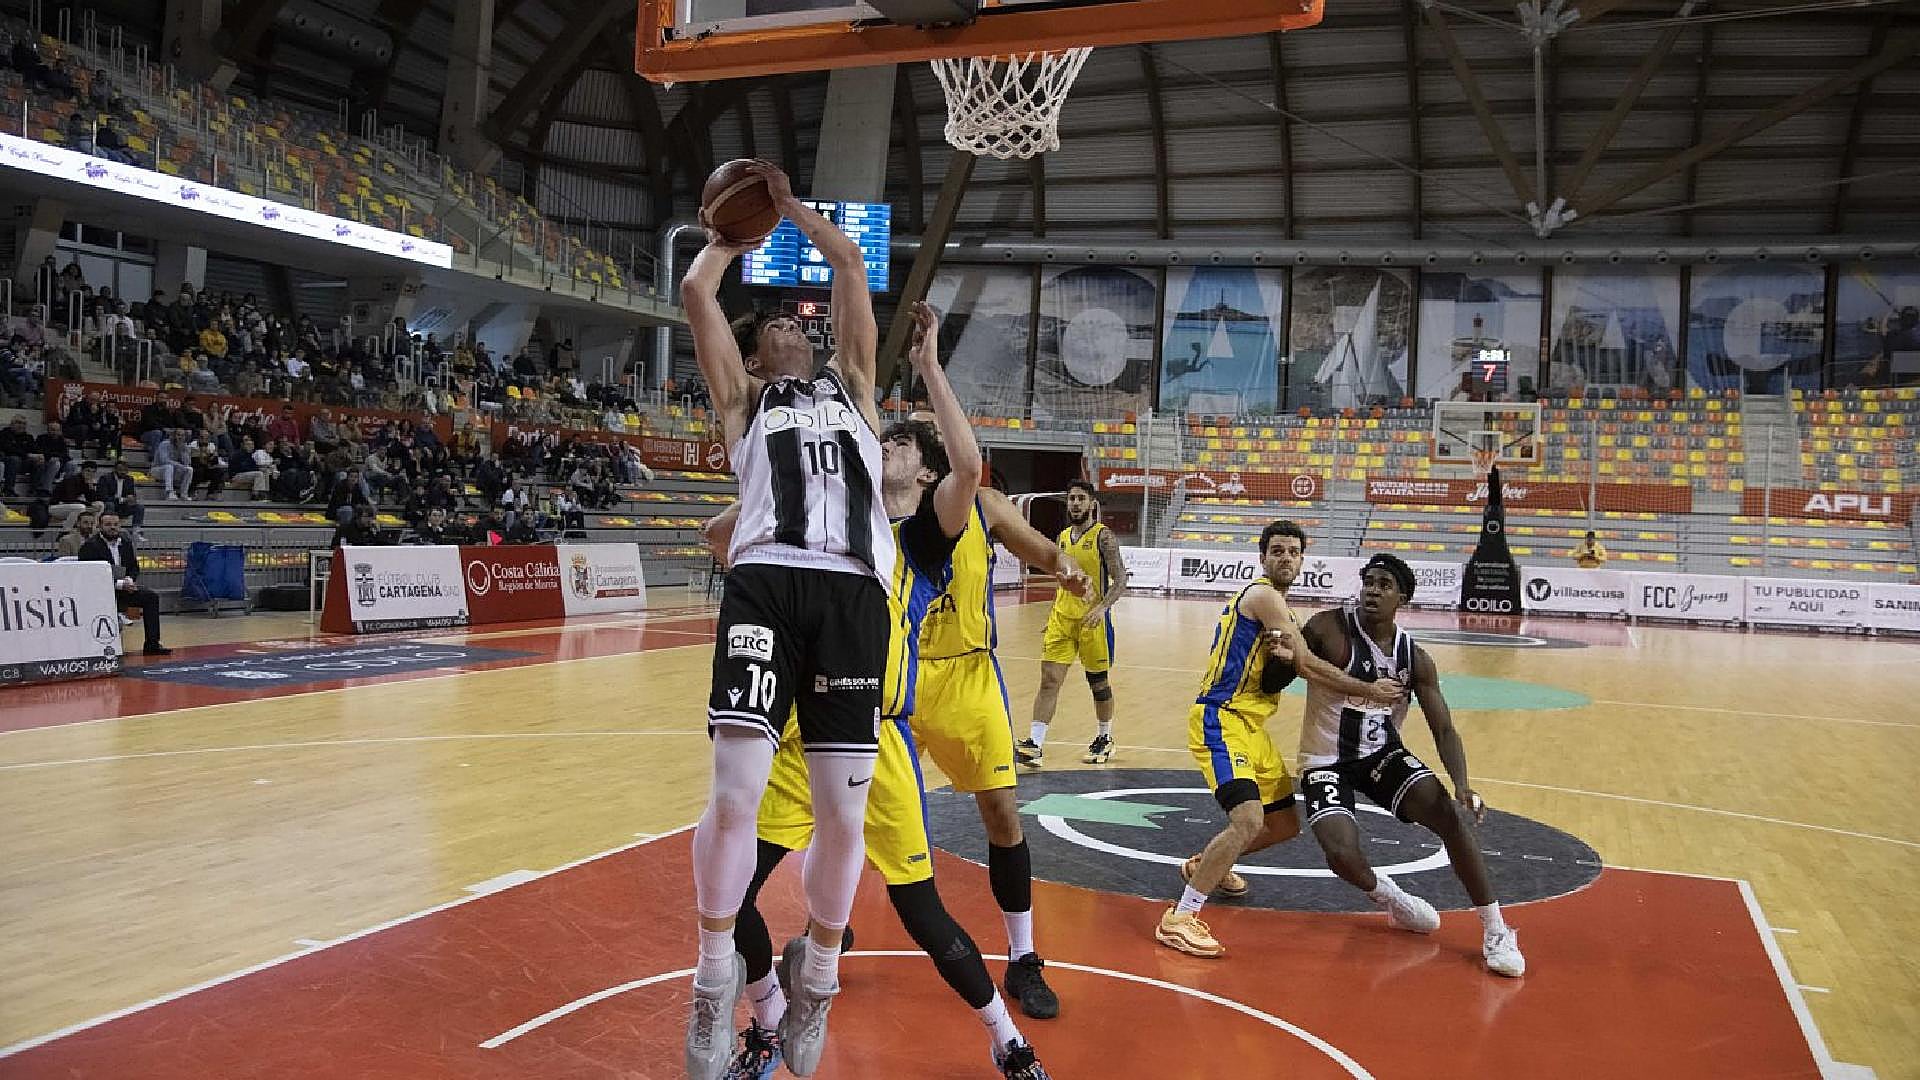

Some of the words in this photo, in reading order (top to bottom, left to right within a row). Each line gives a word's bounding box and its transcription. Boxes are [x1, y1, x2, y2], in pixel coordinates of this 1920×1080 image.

[1483, 365, 1497, 382] 7
[803, 440, 839, 475] 10
[492, 564, 523, 579] Costa
[525, 561, 560, 578] Cálida
[1195, 559, 1255, 583] Ayala
[1414, 568, 1456, 578] CIONES
[498, 580, 522, 593] Región
[524, 580, 534, 589] de
[535, 578, 558, 589] Murcia
[1415, 578, 1456, 587] GENTES
[379, 585, 442, 598] CARTAGENA
[1553, 585, 1625, 599] villaescusa
[1643, 585, 1676, 608] FCC
[1754, 585, 1772, 597] TU
[1776, 586, 1861, 600] PUBLICIDAD
[1466, 597, 1512, 612] ODILO
[731, 635, 768, 653] CRC
[747, 664, 776, 713] 10
[1366, 719, 1379, 742] 2
[1324, 784, 1341, 805] 2
